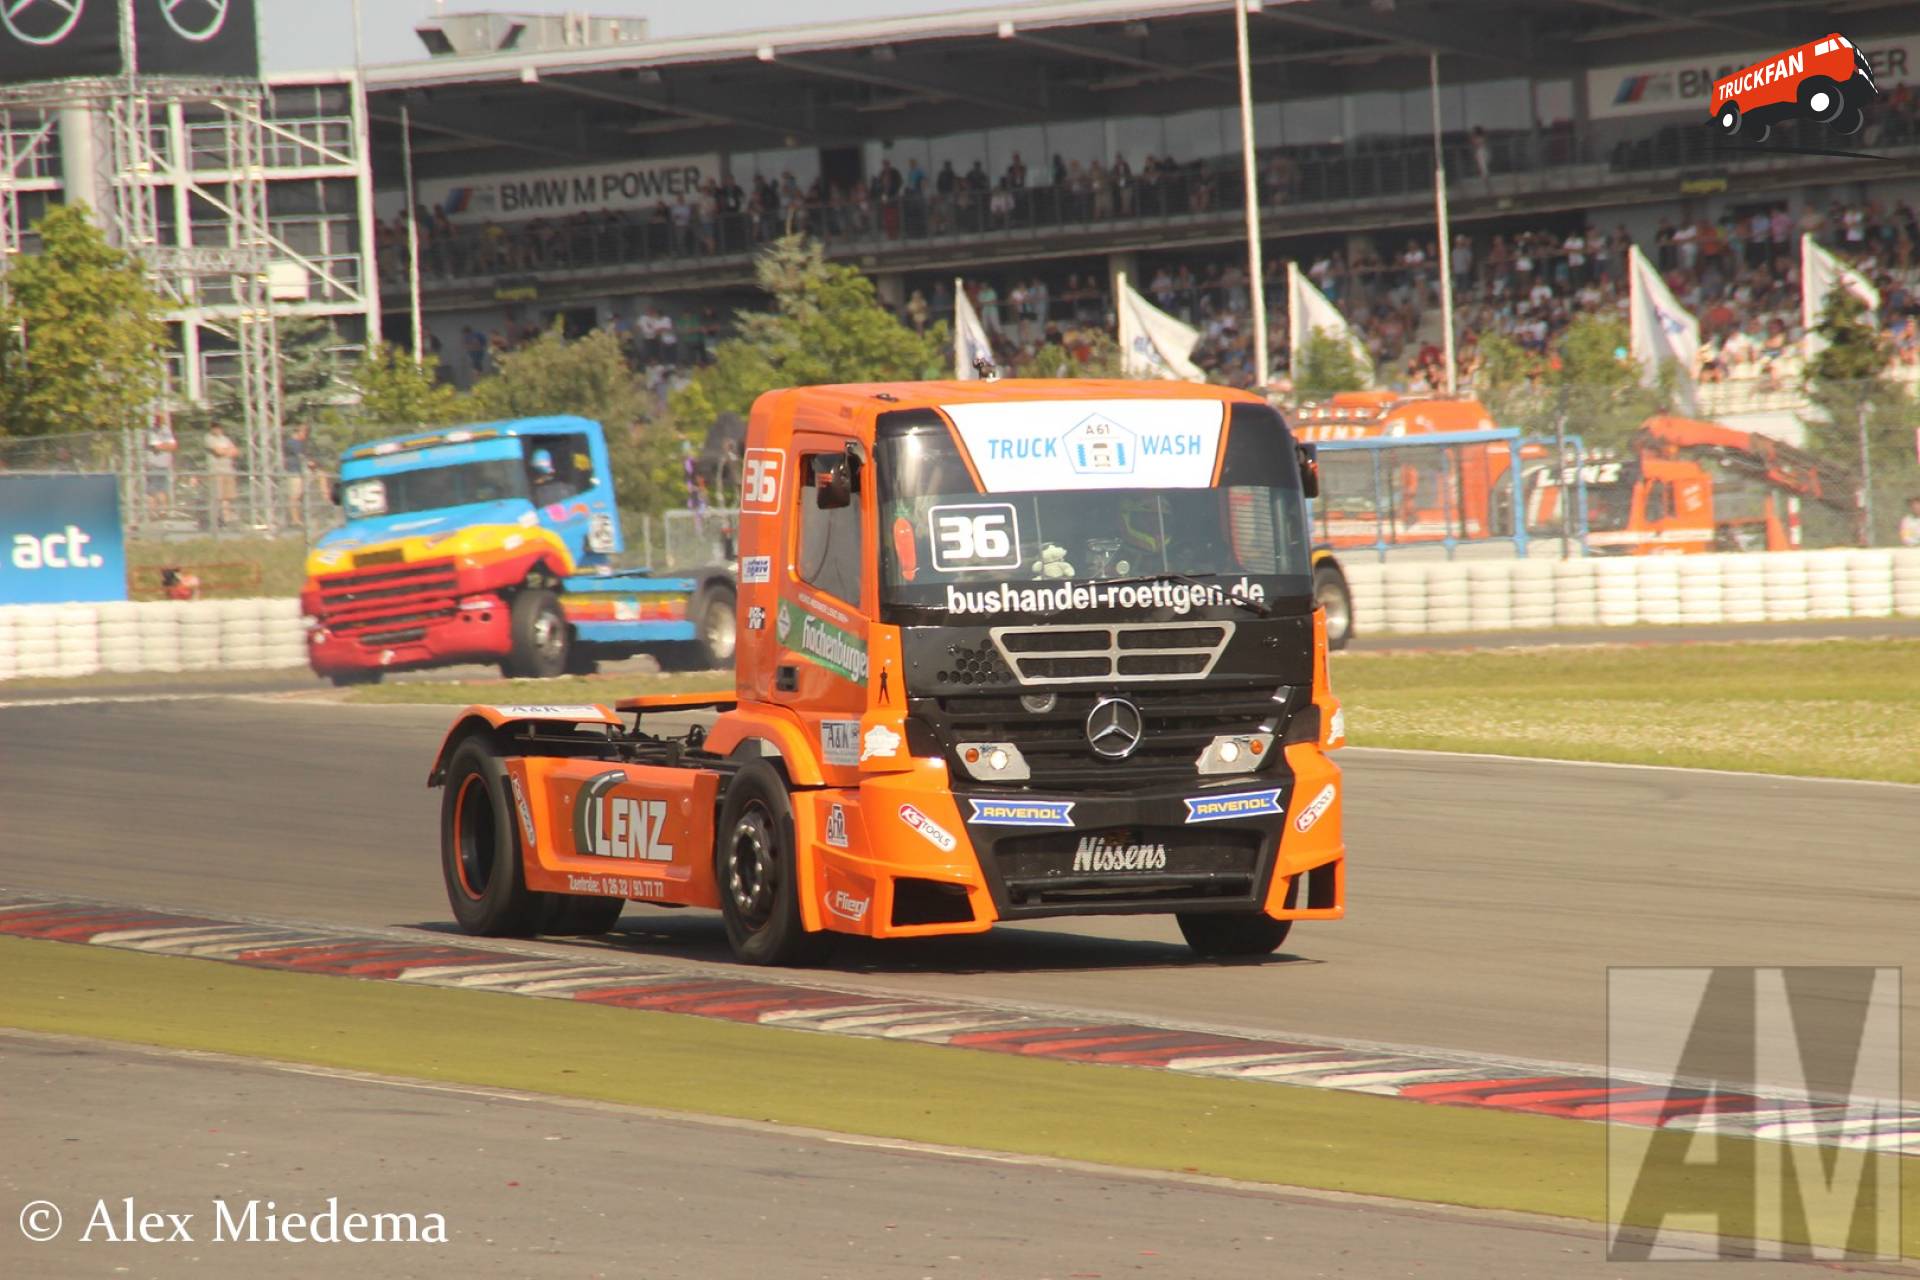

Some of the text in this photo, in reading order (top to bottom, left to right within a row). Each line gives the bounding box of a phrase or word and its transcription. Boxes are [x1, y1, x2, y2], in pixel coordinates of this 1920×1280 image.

[501, 167, 700, 212] BMW M POWER
[988, 434, 1201, 460] TRUCK WASH
[744, 459, 777, 503] 36
[12, 525, 104, 569] act.
[939, 515, 1009, 559] 36
[946, 577, 1265, 615] bushandel-roettgen.de
[983, 807, 1062, 819] RAVENOL
[1197, 798, 1272, 814] RAVENOL
[595, 797, 673, 861] LENZ
[901, 807, 951, 846] KS TOOLS
[1073, 836, 1167, 871] Nissens
